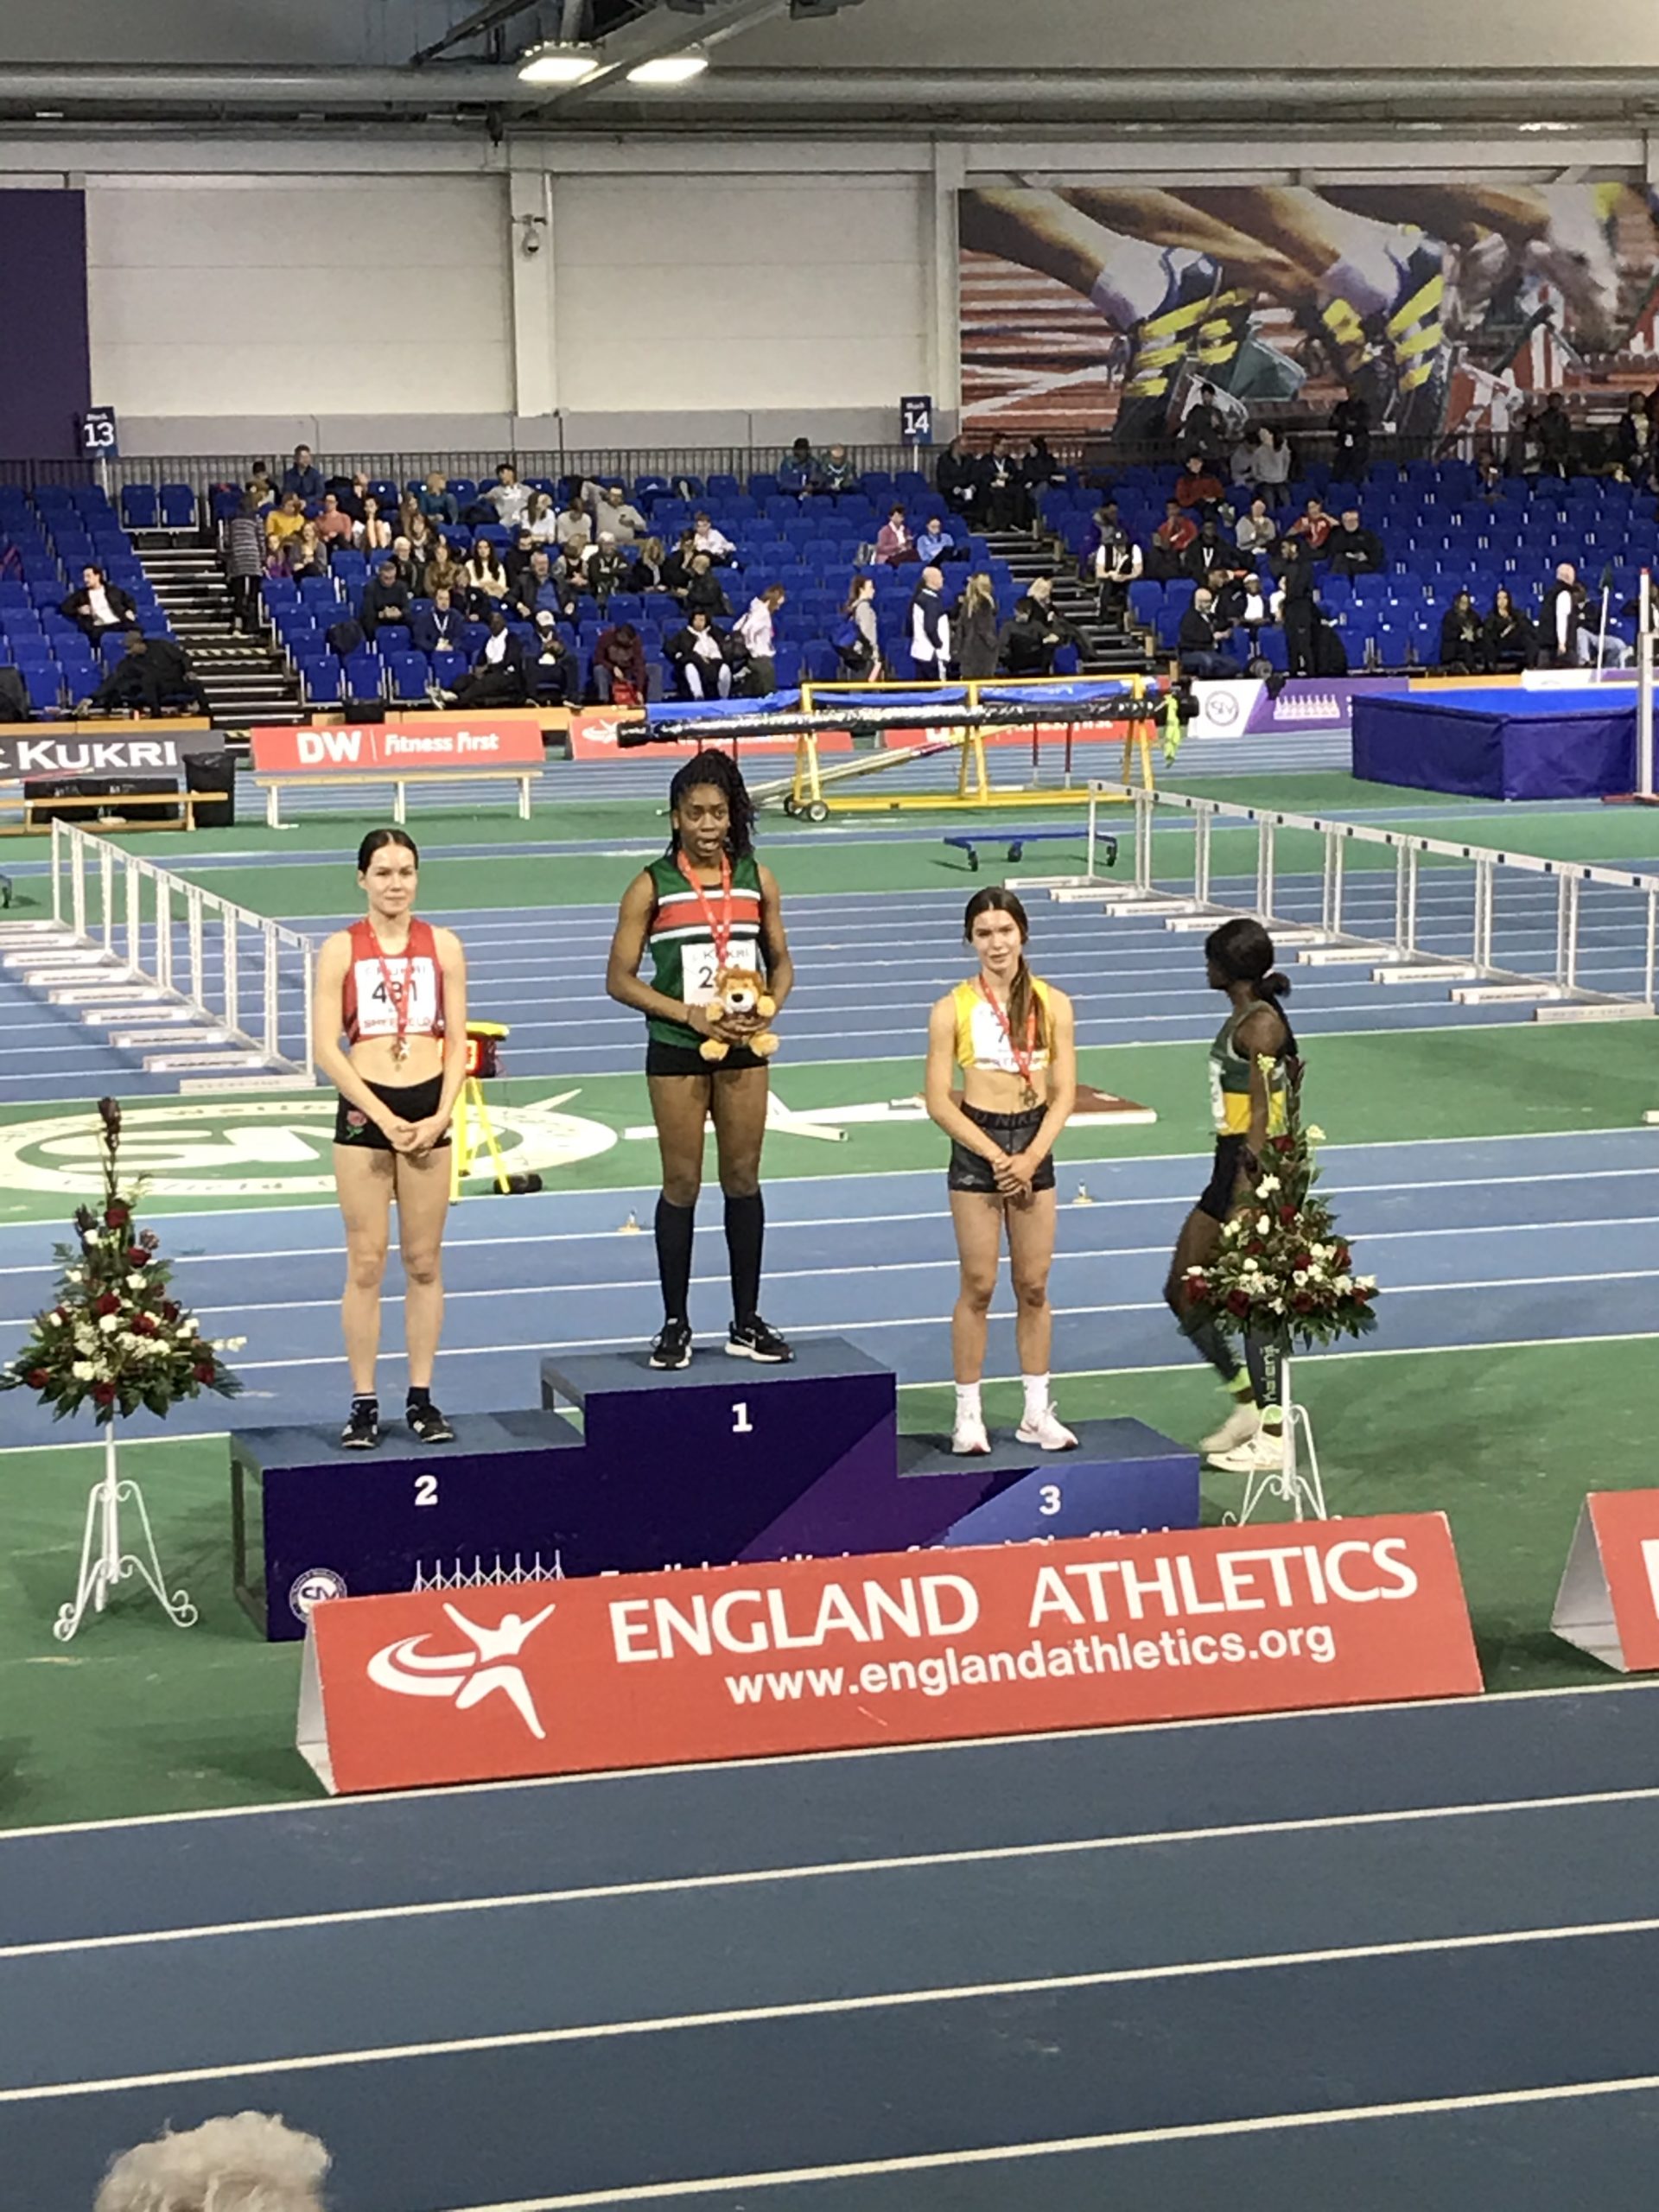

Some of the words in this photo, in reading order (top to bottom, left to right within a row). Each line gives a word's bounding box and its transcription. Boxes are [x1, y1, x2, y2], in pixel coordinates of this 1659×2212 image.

[84, 422, 114, 447] 13
[904, 410, 930, 434] 14
[16, 740, 178, 770] KUKRI
[296, 730, 361, 764] DW
[731, 1402, 753, 1433] 1
[414, 1474, 439, 1506] 2
[1039, 1485, 1062, 1515] 3
[608, 1573, 980, 1663] ENGLAND
[1028, 1538, 1418, 1628] ATHLETICS
[724, 1624, 1336, 1705] www.englandathletics.org
